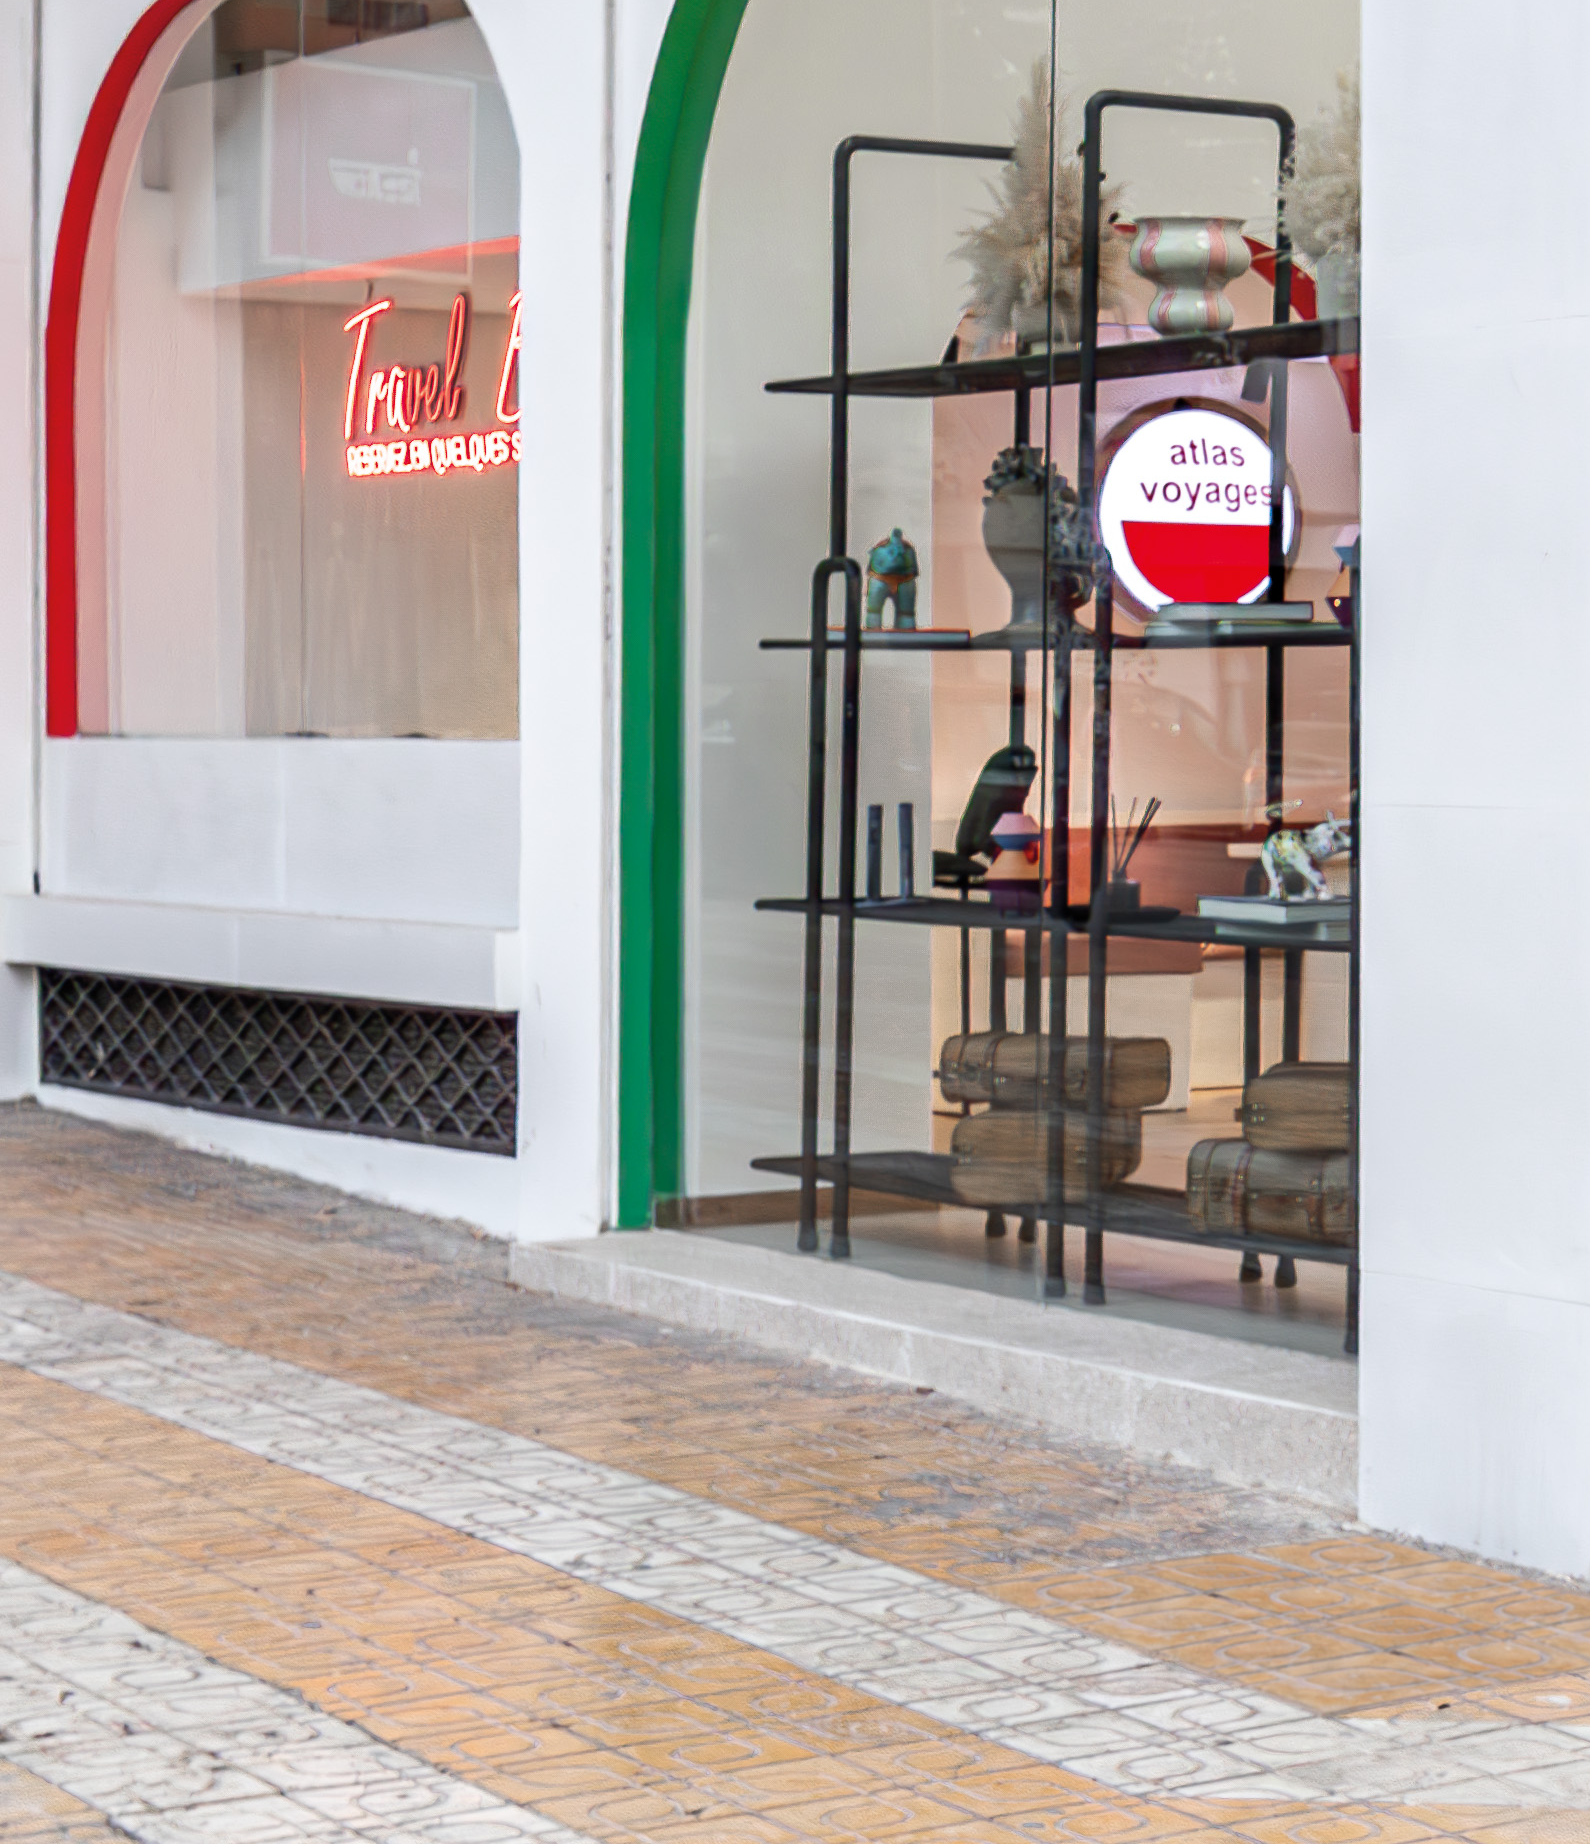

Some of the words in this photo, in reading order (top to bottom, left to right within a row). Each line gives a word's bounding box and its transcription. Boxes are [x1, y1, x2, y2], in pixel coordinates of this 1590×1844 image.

[343, 293, 466, 441] Travel
[1170, 437, 1246, 467] atlas
[1139, 481, 1272, 513] voyages
